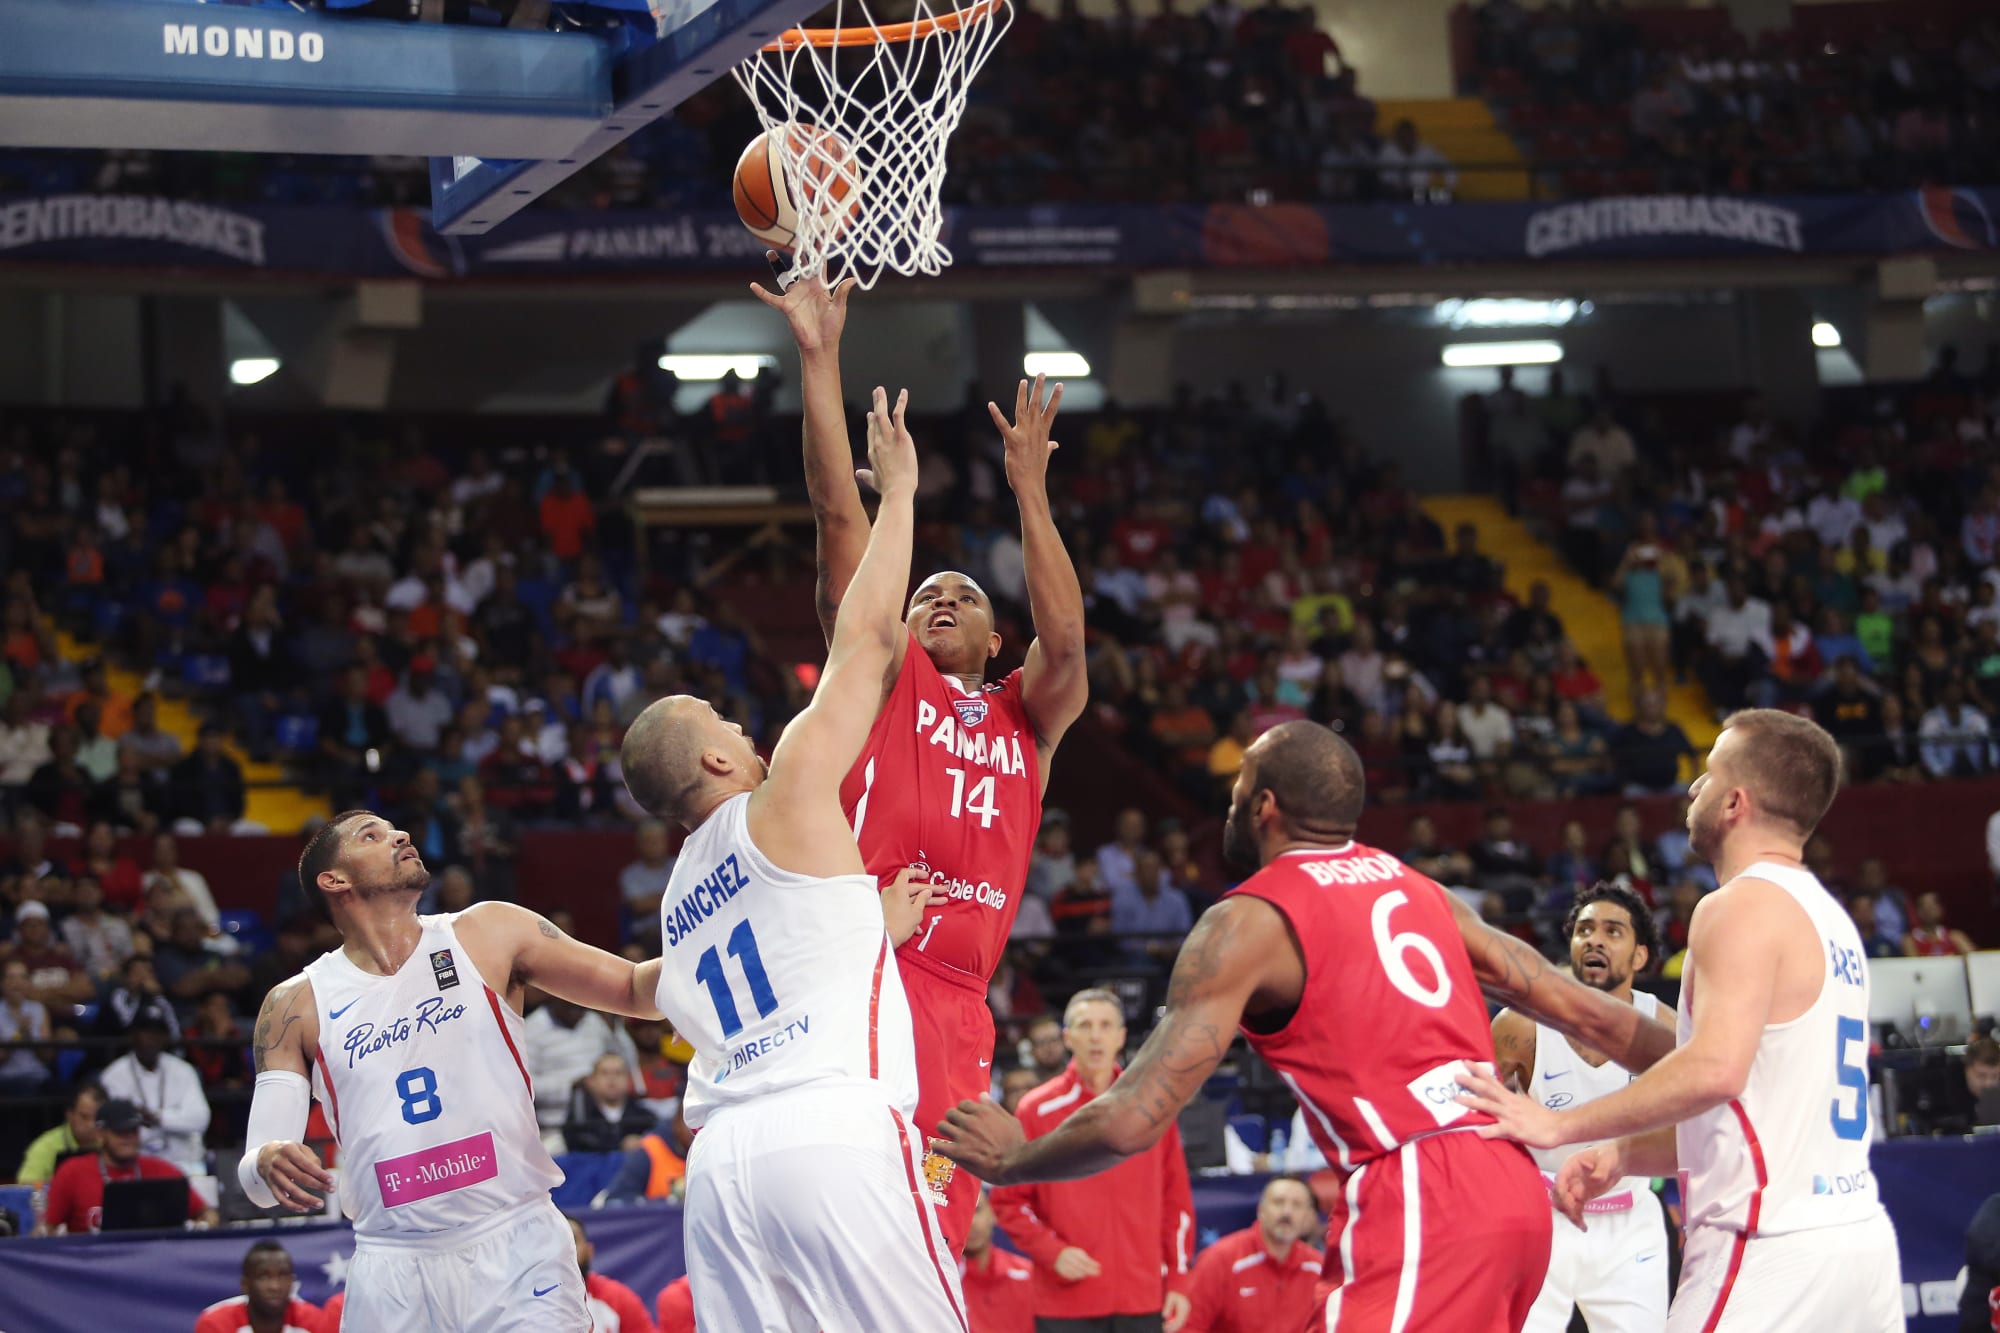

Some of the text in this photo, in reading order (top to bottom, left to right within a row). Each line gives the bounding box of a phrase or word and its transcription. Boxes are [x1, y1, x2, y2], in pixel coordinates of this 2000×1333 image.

[164, 23, 324, 62] MONDO
[1525, 195, 1803, 259] CENTROBASKET
[916, 699, 1026, 778] PANAMÁ
[945, 767, 1000, 829] 14
[666, 852, 750, 947] SANCHEZ
[975, 881, 1007, 910] Onda
[1298, 853, 1405, 887] BISHOP
[438, 969, 454, 981] FIBA
[695, 918, 779, 1041] 11
[1371, 889, 1452, 1008] 6
[344, 996, 468, 1069] Puerto Rico
[733, 1015, 809, 1071] DIRECTV
[395, 1066, 442, 1125] 8
[1830, 1015, 1868, 1141] 5
